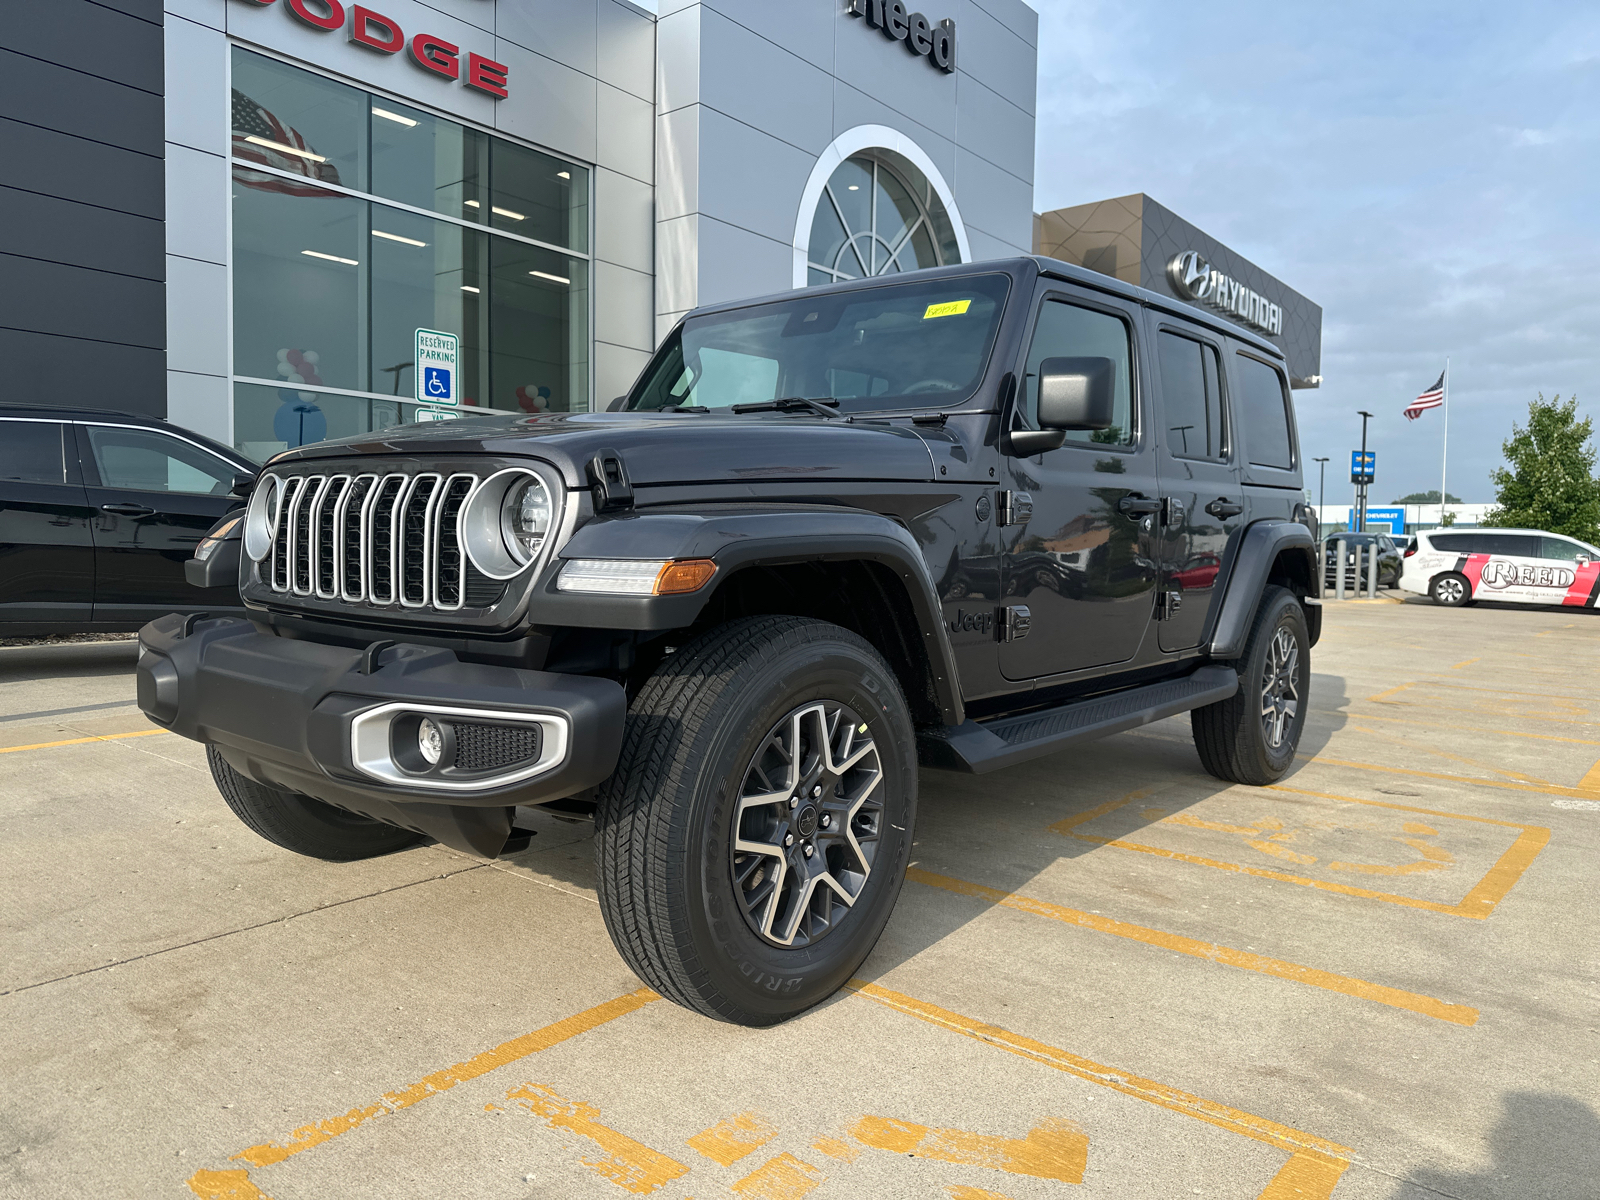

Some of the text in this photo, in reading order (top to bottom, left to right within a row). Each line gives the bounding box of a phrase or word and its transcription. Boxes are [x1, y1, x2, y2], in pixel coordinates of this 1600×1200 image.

[238, 0, 509, 100] ODGE
[847, 0, 956, 74] eed
[1215, 272, 1282, 336] HYUNDAI
[420, 336, 454, 351] RESERVED
[420, 349, 454, 363] PARKING
[1482, 560, 1574, 588] REED
[951, 608, 993, 634] Jeep
